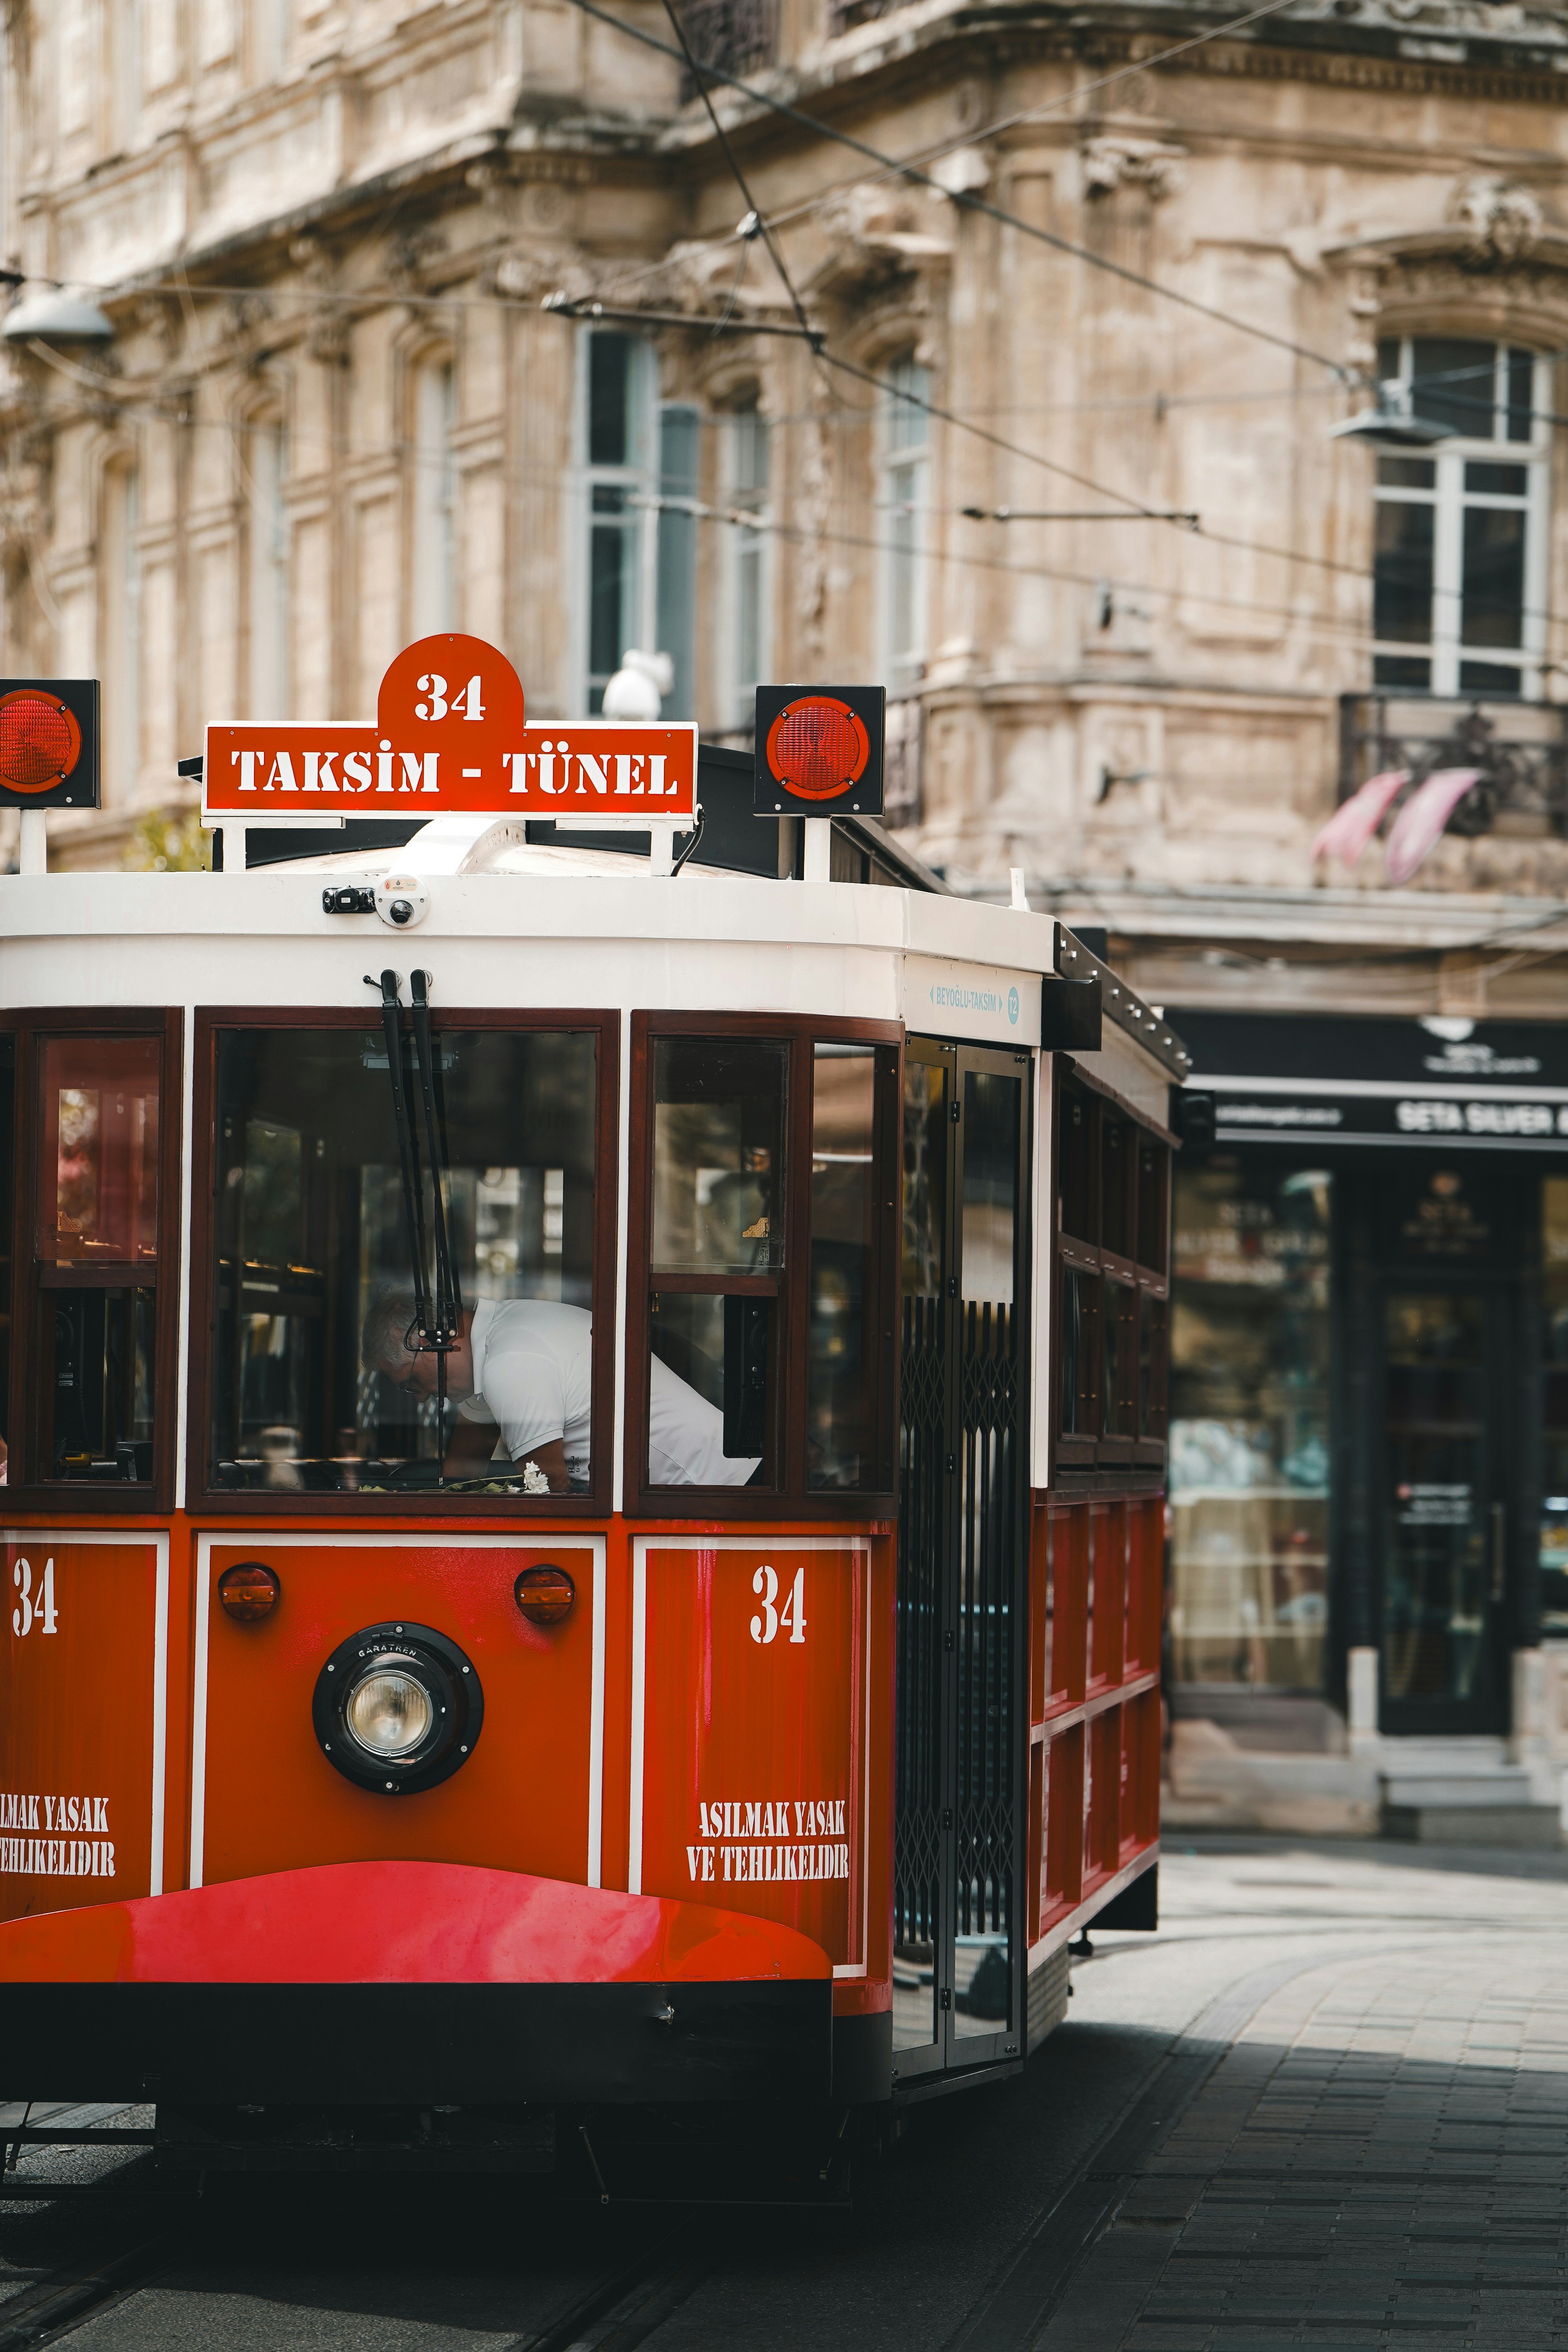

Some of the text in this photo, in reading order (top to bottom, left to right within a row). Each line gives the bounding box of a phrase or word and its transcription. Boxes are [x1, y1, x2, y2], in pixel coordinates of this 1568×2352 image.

[415, 674, 486, 721] 34
[232, 739, 677, 795] TAKSİM - TÜNEL
[936, 984, 996, 1012] BEYOĞLU-TAKSİM
[1009, 996, 1017, 1015] T2
[1465, 1102, 1555, 1136] SILVER
[13, 1558, 58, 1637] 34
[750, 1565, 807, 1644] 34
[359, 1644, 416, 1657] GARATREN
[0, 1794, 109, 1832] LMAK YASAK
[699, 1800, 845, 1838] ASILMAK YASAK
[0, 1837, 116, 1877] EHLIKELIDIR
[686, 1844, 849, 1881] VE TEHLIKELIDIR
